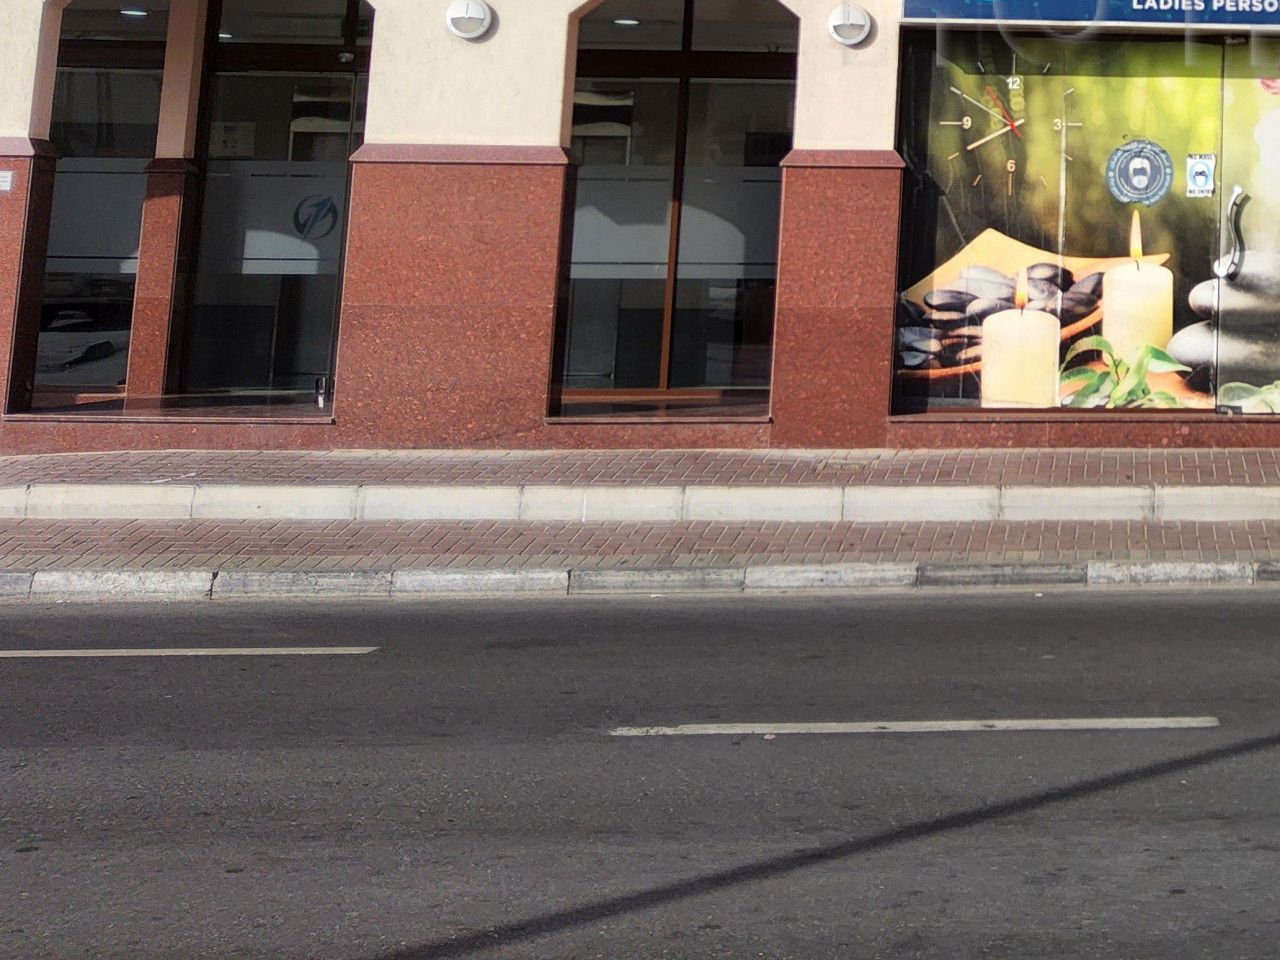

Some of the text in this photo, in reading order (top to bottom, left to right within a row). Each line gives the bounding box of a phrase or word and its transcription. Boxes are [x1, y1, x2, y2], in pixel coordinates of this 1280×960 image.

[1006, 77, 1021, 90] 12
[962, 116, 973, 130] 9
[1053, 118, 1063, 131] 3
[1006, 160, 1016, 172] 6
